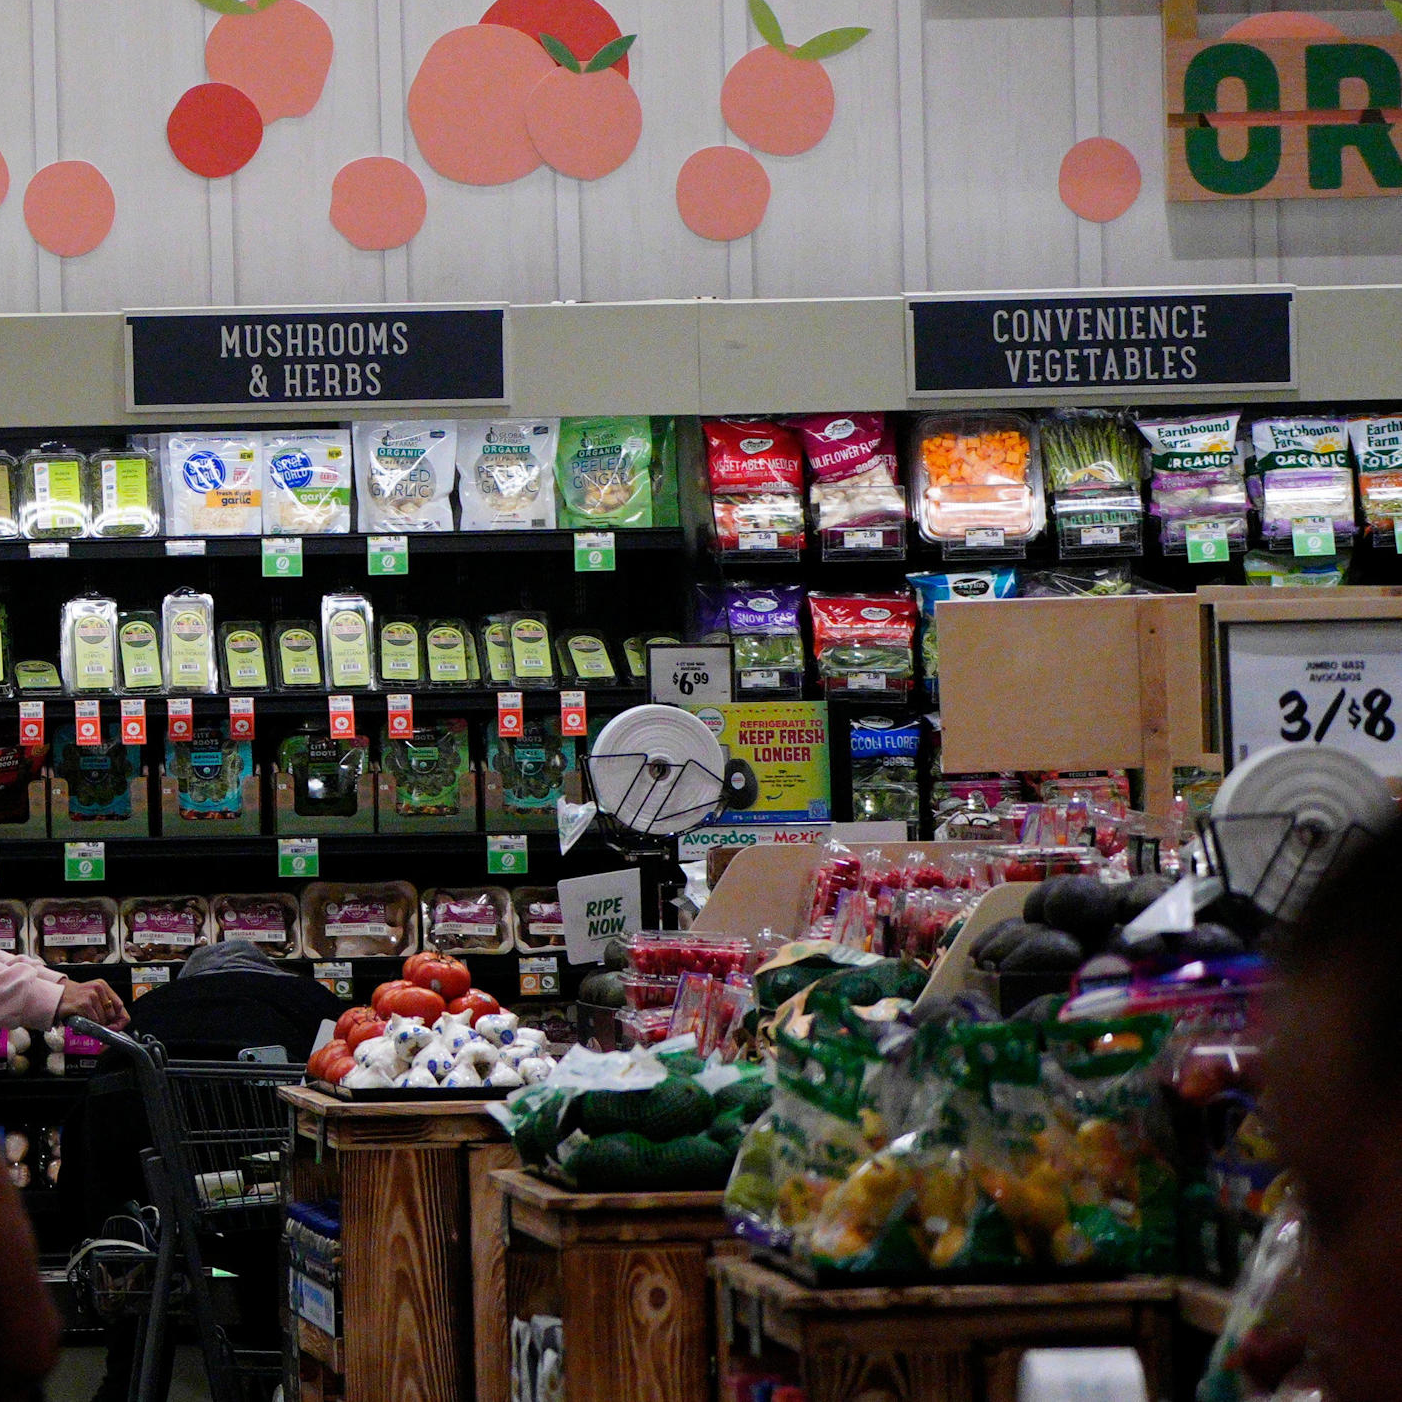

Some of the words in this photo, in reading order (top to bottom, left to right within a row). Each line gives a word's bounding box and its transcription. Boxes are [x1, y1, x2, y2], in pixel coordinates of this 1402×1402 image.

[992, 305, 1207, 343] CONVENIENCE
[220, 321, 409, 358] MUSHROOMS
[1005, 346, 1198, 383] VEGETABLES
[248, 364, 270, 398] &
[284, 362, 382, 397] HERBS
[1158, 420, 1230, 438] Earthbound
[1367, 436, 1400, 447] Farm
[379, 449, 425, 457] ORGANIC
[484, 446, 529, 454] ORGANIC
[578, 446, 621, 458] ORGANIC
[572, 458, 627, 473] PEELED
[767, 460, 798, 471] MEDLEY
[1275, 453, 1346, 466] ORGANIC
[221, 496, 252, 506] garlic
[737, 612, 764, 624] SNOW
[740, 719, 807, 729] REFRIGERATE
[810, 719, 823, 727] TO
[739, 730, 775, 745] KEEP
[780, 729, 825, 744] FRESH
[0, 754, 13, 762] CITY
[754, 747, 811, 762] LONGER
[683, 830, 757, 846] Avocados
[586, 897, 623, 918] RIPE
[588, 916, 627, 937] NOW
